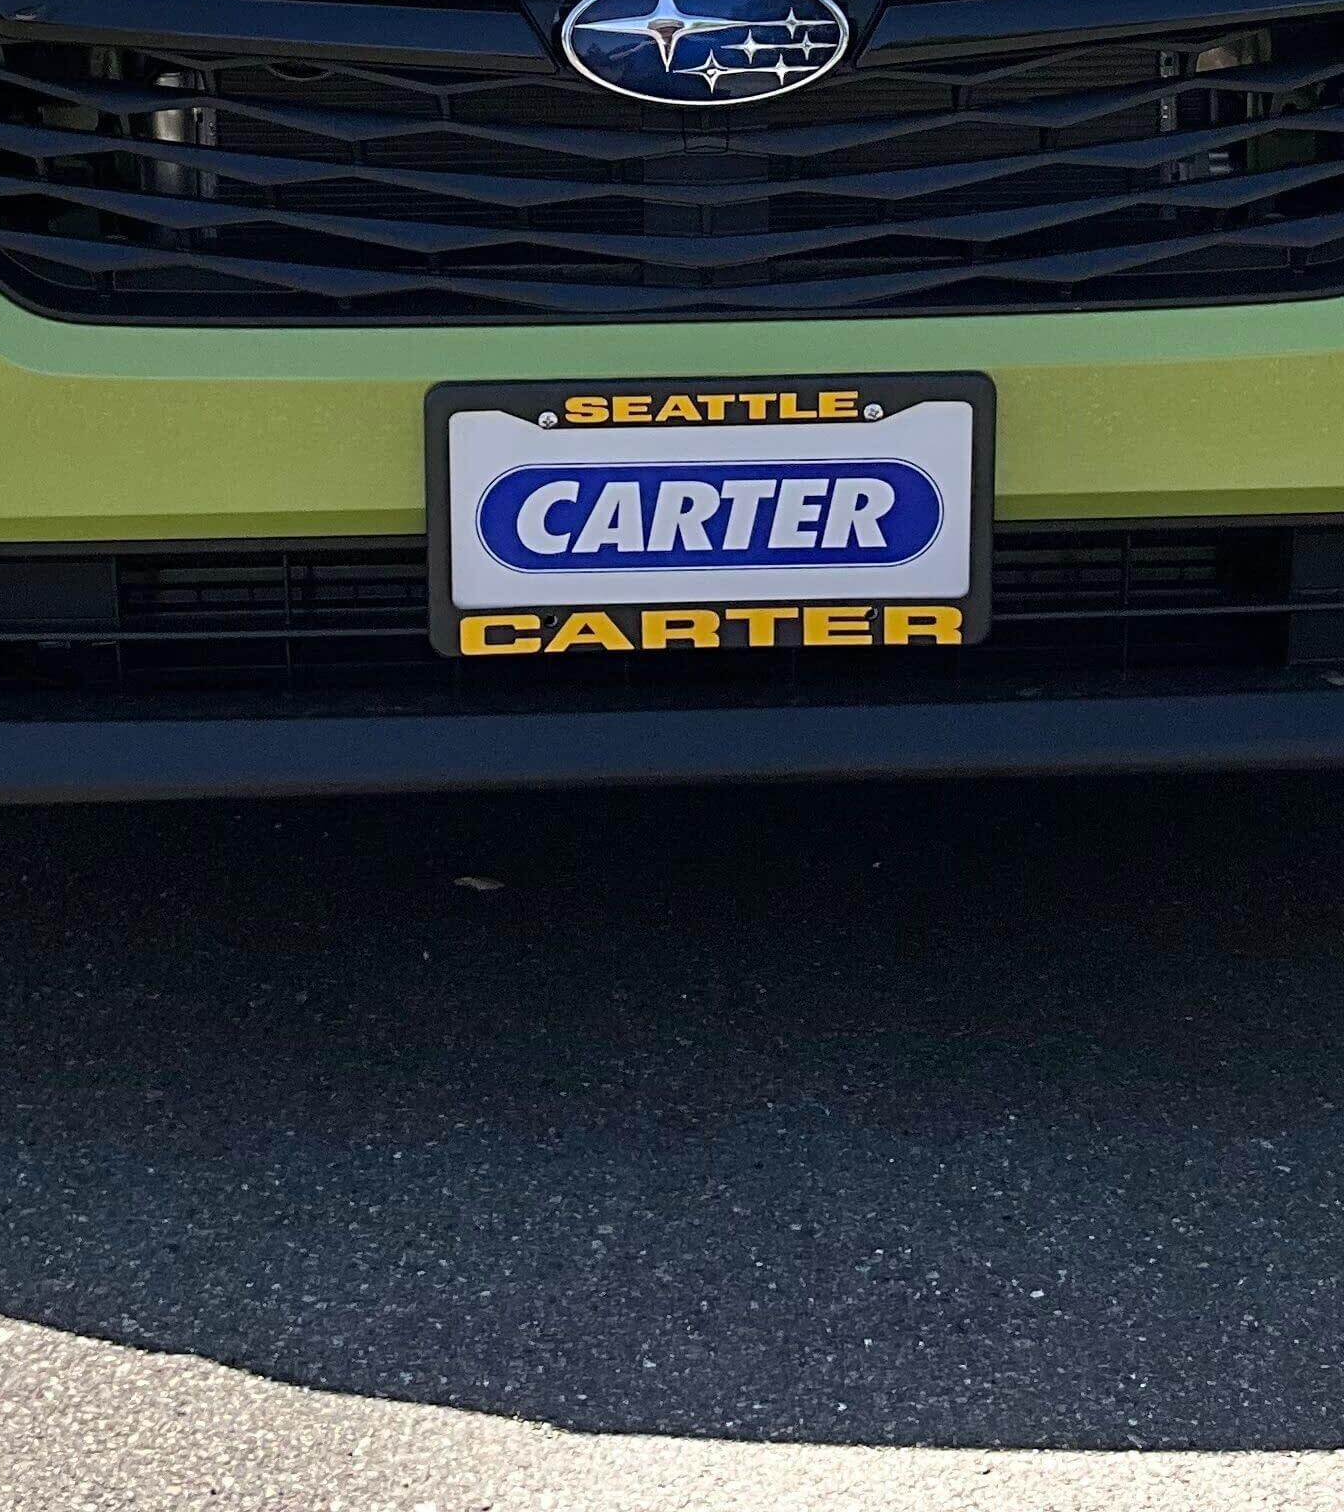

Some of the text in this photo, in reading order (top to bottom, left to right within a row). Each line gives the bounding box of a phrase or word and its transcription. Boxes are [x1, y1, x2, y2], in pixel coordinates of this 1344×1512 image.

[565, 392, 858, 423] SEATTLE
[517, 478, 895, 554] CARTER
[460, 607, 962, 655] CARTER
